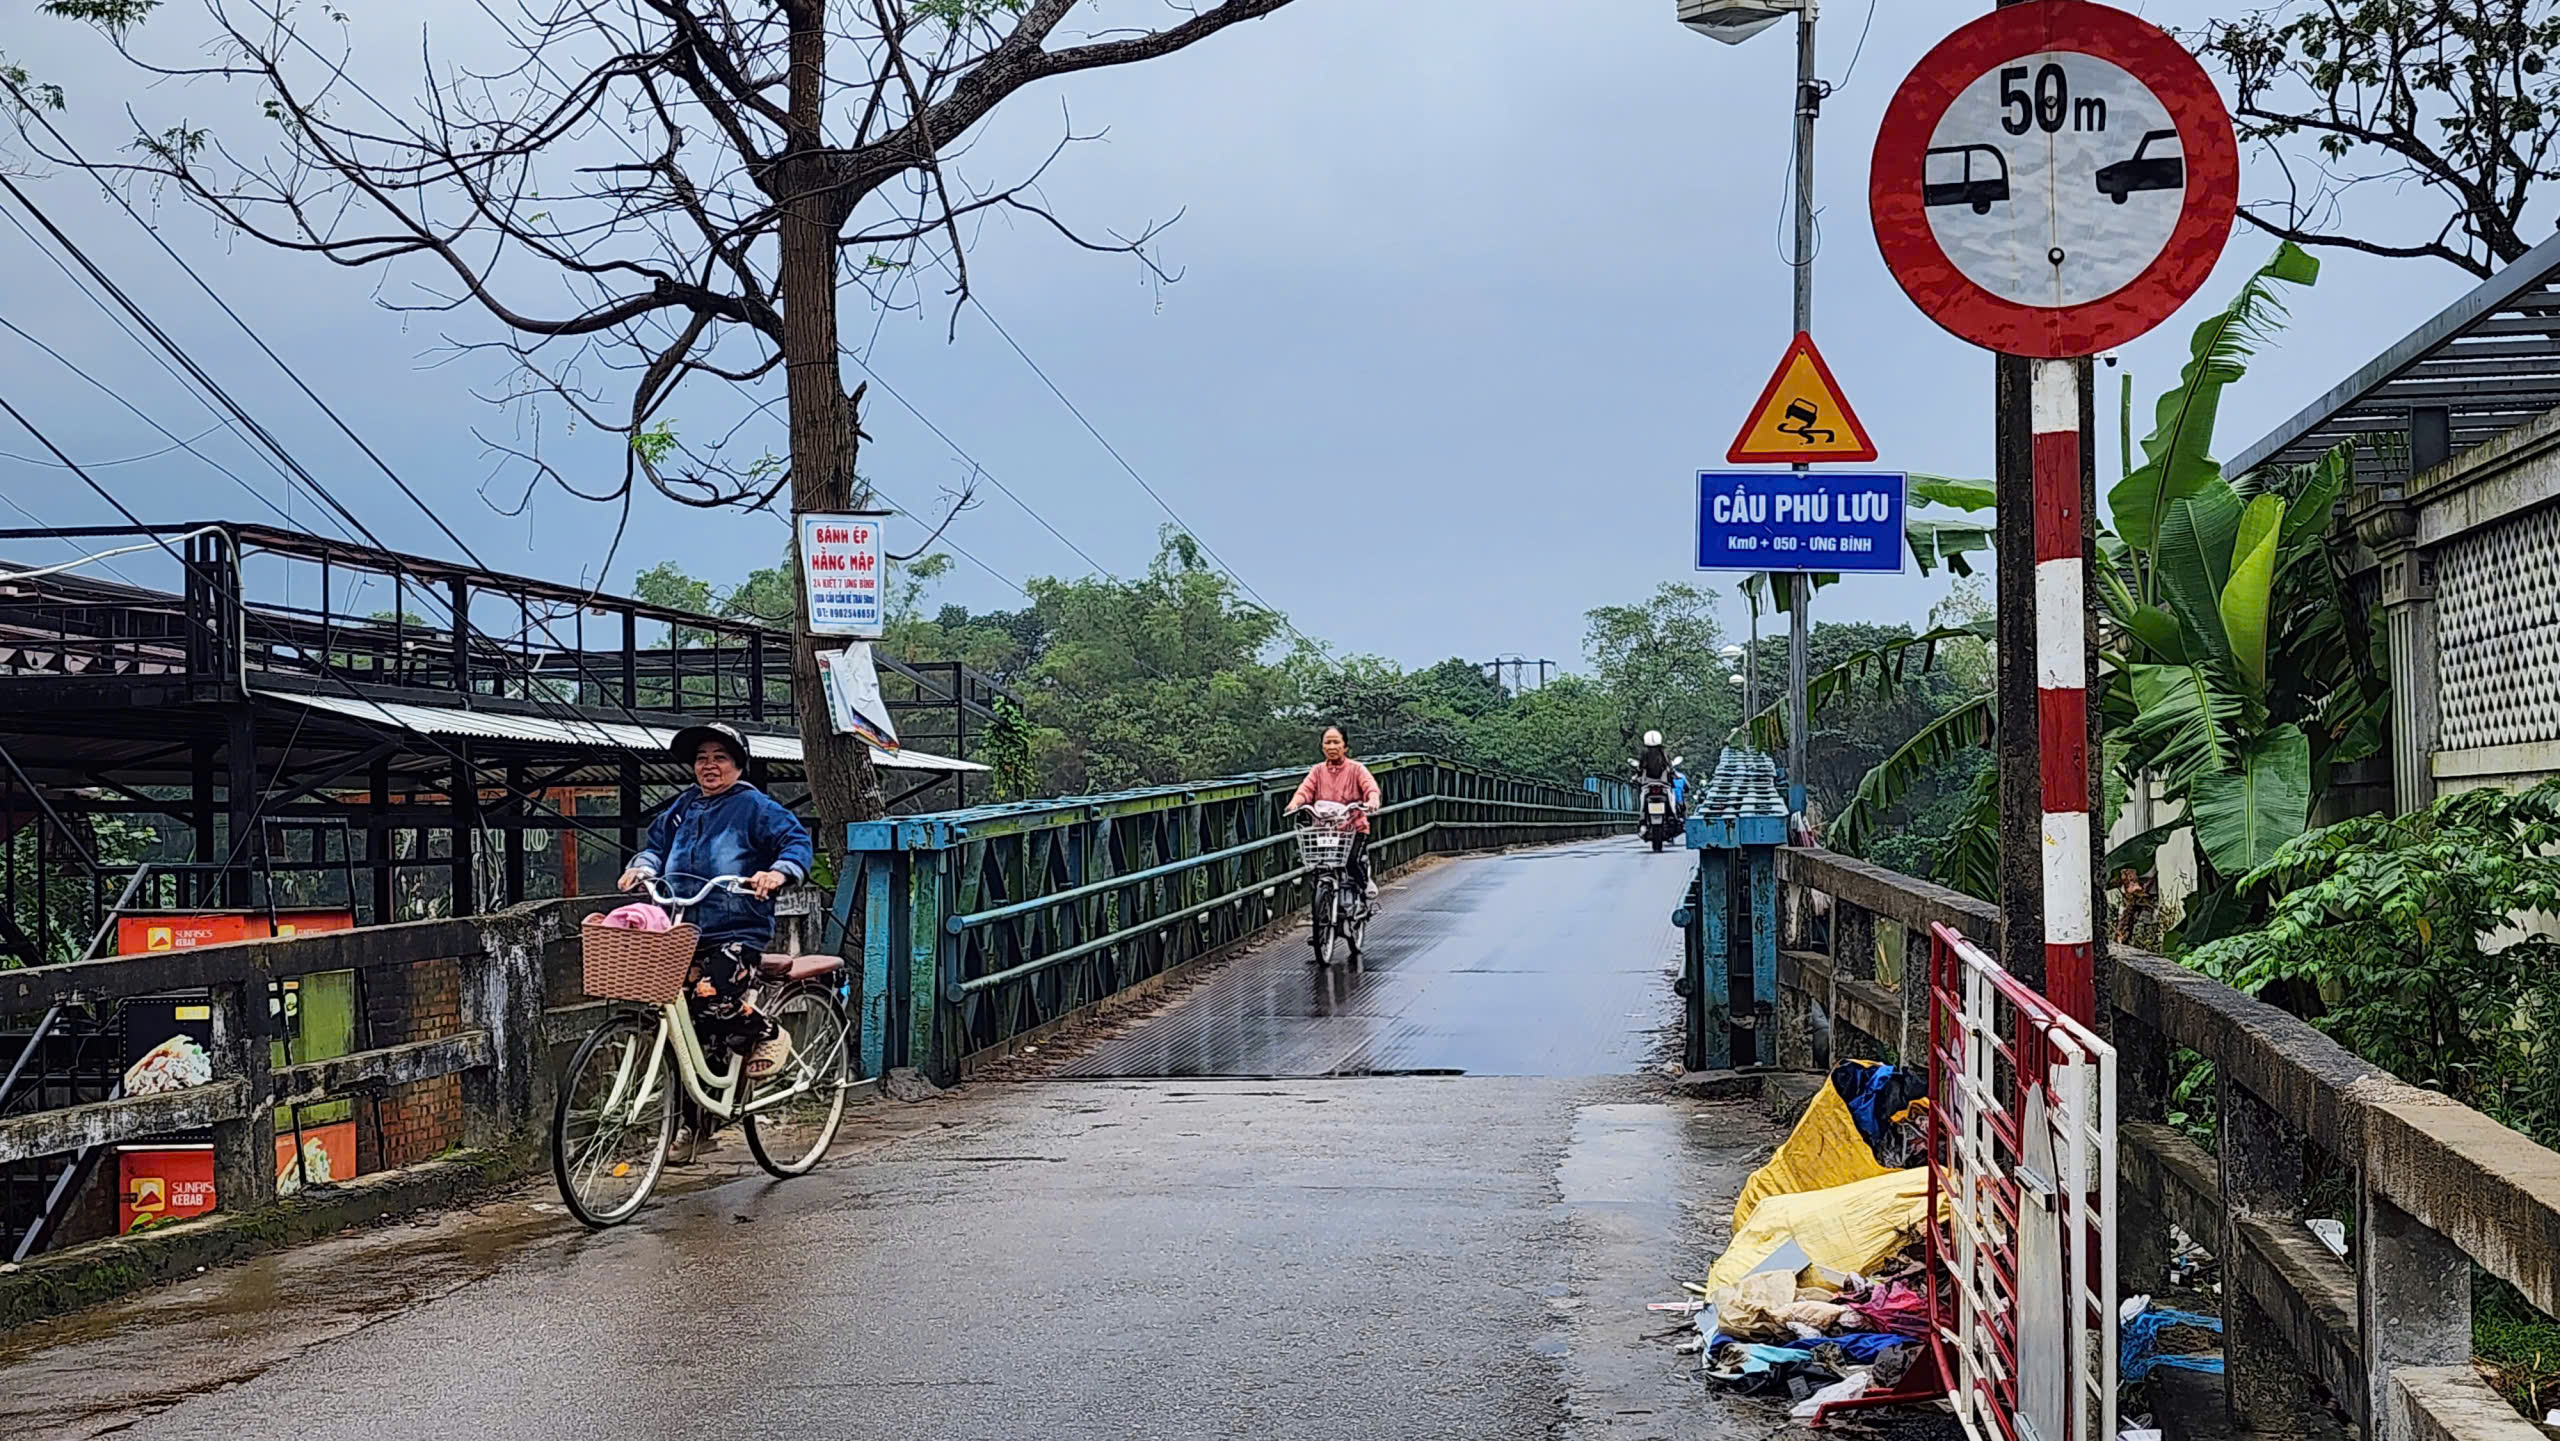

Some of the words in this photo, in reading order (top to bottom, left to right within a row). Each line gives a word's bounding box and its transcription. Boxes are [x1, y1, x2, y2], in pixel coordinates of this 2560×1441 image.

[1713, 484, 1767, 524] CẦU
[1775, 487, 1829, 523] PHÚ
[1837, 490, 1889, 523] LƯU
[816, 525, 849, 544] BÁNH
[853, 526, 868, 544] ÉP
[1728, 535, 1757, 551] Km0
[1760, 538, 1770, 548] +
[1773, 536, 1798, 551] 050
[1810, 535, 1837, 552] ƯNG
[1840, 534, 1872, 553] BÌNH
[811, 546, 846, 571] HẰNG
[849, 551, 875, 575] MẬP
[171, 1194, 204, 1206] KEBAB
